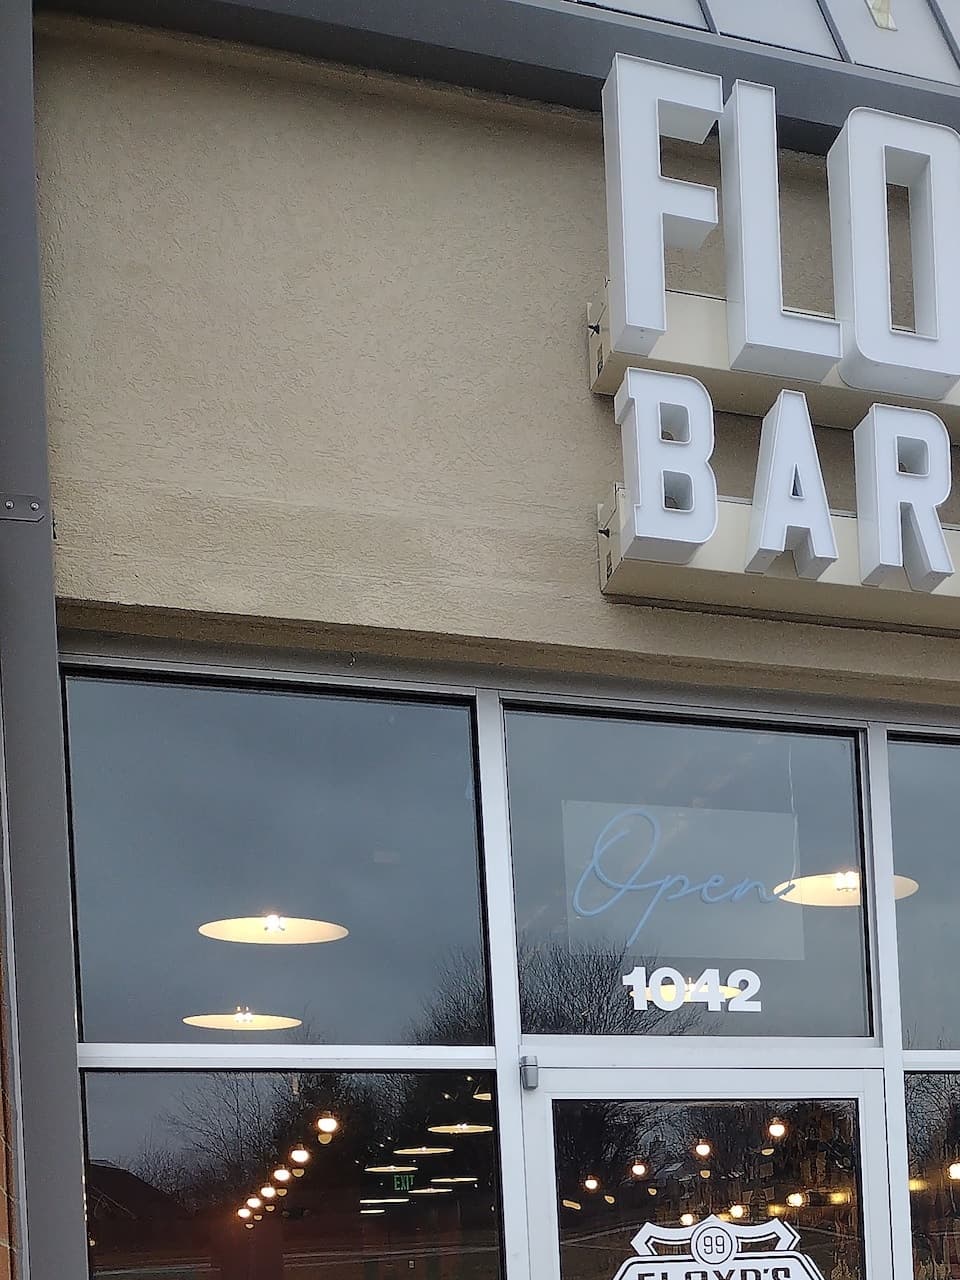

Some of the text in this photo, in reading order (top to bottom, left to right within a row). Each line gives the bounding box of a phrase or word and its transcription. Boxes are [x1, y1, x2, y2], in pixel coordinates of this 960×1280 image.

[572, 808, 796, 947] Open
[622, 966, 761, 1013] 1042
[393, 1174, 416, 1191] EXIT
[703, 1235, 725, 1254] 99
